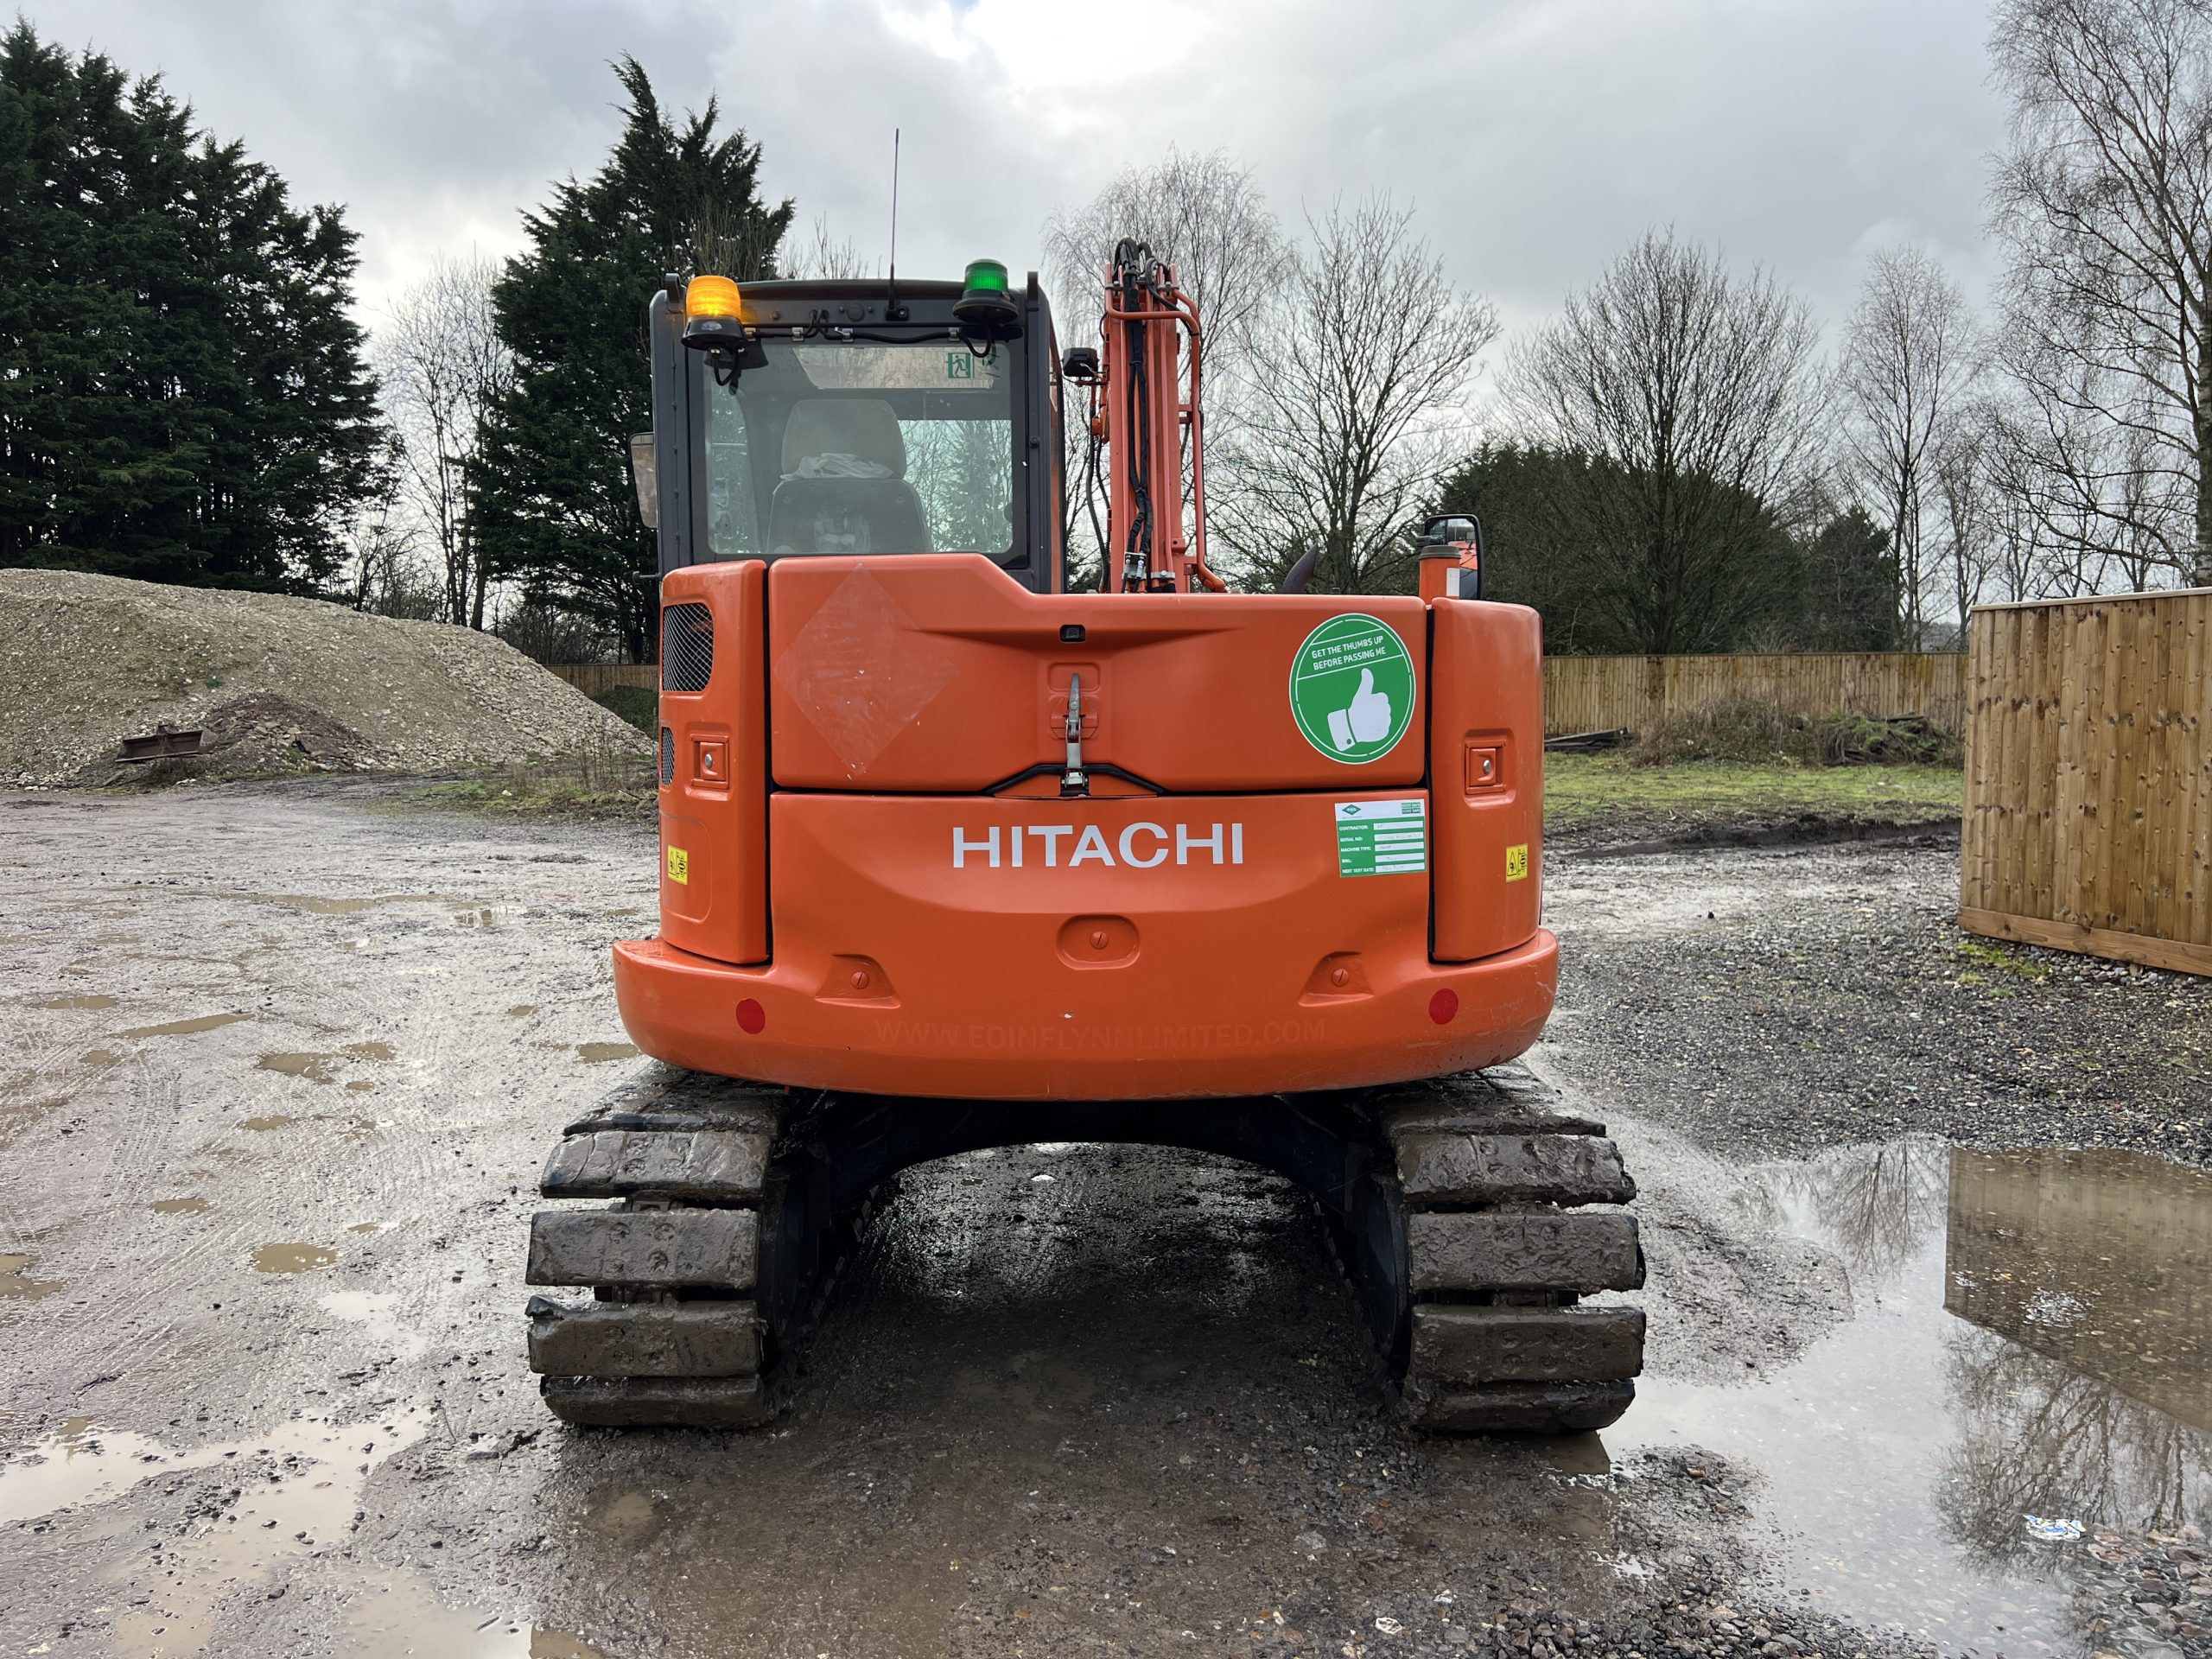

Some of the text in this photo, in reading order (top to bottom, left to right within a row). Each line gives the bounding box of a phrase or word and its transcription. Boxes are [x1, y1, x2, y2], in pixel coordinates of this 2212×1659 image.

[1312, 635, 1383, 659] GET THE THUMBS UP
[1313, 646, 1387, 671] BEFORE PASSING ME
[953, 822, 1243, 868] HITACHI
